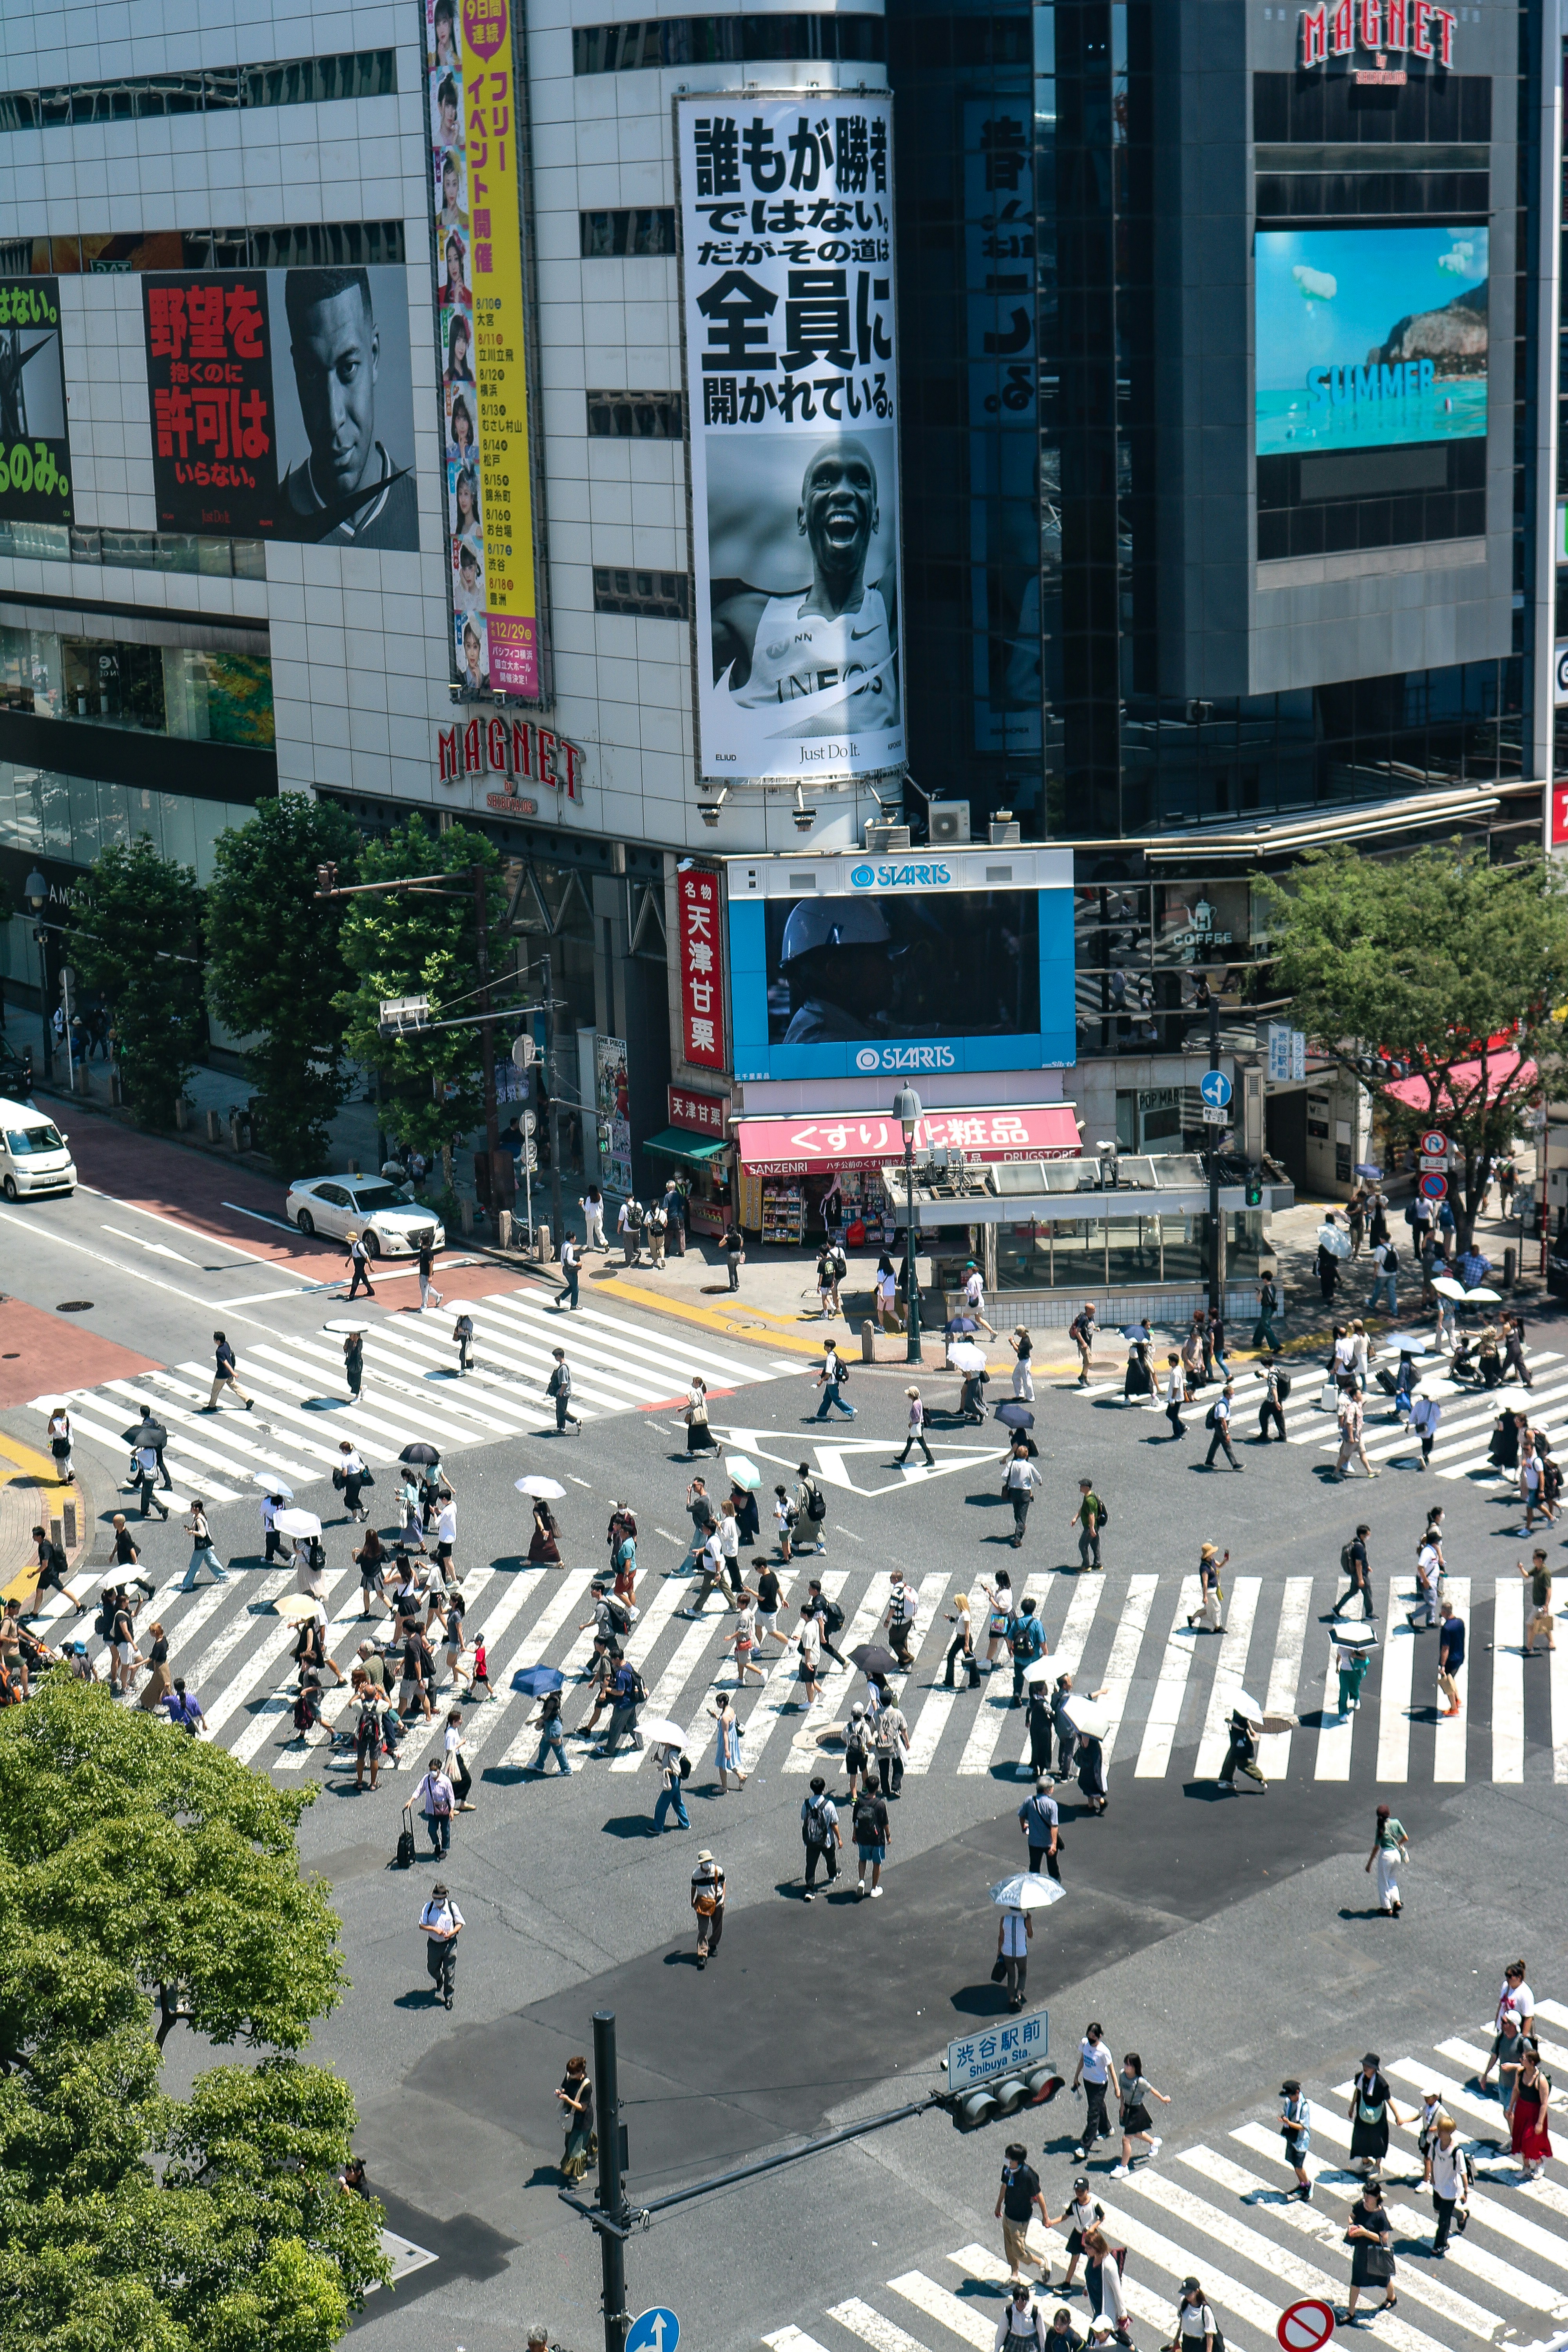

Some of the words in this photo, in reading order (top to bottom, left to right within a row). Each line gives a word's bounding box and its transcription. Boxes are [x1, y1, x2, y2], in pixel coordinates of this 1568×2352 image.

[472, 23, 499, 44] 連続
[1303, 0, 1457, 69] MAGNET
[490, 72, 509, 171] フリー
[695, 115, 887, 196] 誰もが勝者
[468, 74, 493, 273] イベント開催
[695, 198, 888, 235] ではない。
[697, 239, 889, 266] だがその道は
[148, 285, 264, 359] 野望を
[477, 313, 494, 326] 大宮
[696, 268, 892, 373] 全員に
[170, 362, 243, 384] 抱くのに
[1306, 358, 1435, 410] SUMMER
[480, 384, 497, 397] 横浜
[702, 372, 893, 426] 開かれている。
[154, 385, 270, 459] 許可は
[482, 419, 522, 433] むさし村山
[483, 454, 501, 466] 松戸
[175, 461, 256, 488] いらない。
[487, 523, 512, 537] お台場
[488, 558, 505, 572] 渋谷
[490, 592, 506, 606] 豊洲
[794, 632, 813, 643] NN
[438, 717, 583, 806] MAGNET
[799, 746, 825, 764] Just
[828, 744, 848, 759] Do
[849, 742, 860, 757] It.
[503, 778, 514, 797] by
[486, 792, 533, 814] SHIBUYA109
[877, 862, 952, 886] STARTS
[685, 880, 712, 901] 名物
[1174, 932, 1232, 946] COFFEE
[687, 904, 715, 1053] 天津甘栗
[610, 1039, 626, 1049] PIECE
[882, 1046, 955, 1069] STARTS
[672, 1097, 721, 1126] 天津甘栗
[791, 1123, 888, 1152] くすり
[914, 1117, 1030, 1149] 化粧品
[826, 1157, 906, 1170] ハチ公前のくすり屋さん
[1003, 1149, 1076, 1161] DRUGSTORE
[749, 1162, 808, 1175] SANZENRI
[956, 2019, 1040, 2069] 渋谷駅前
[969, 2056, 1008, 2078] Shibuya
[1012, 2048, 1031, 2062] Sta.
